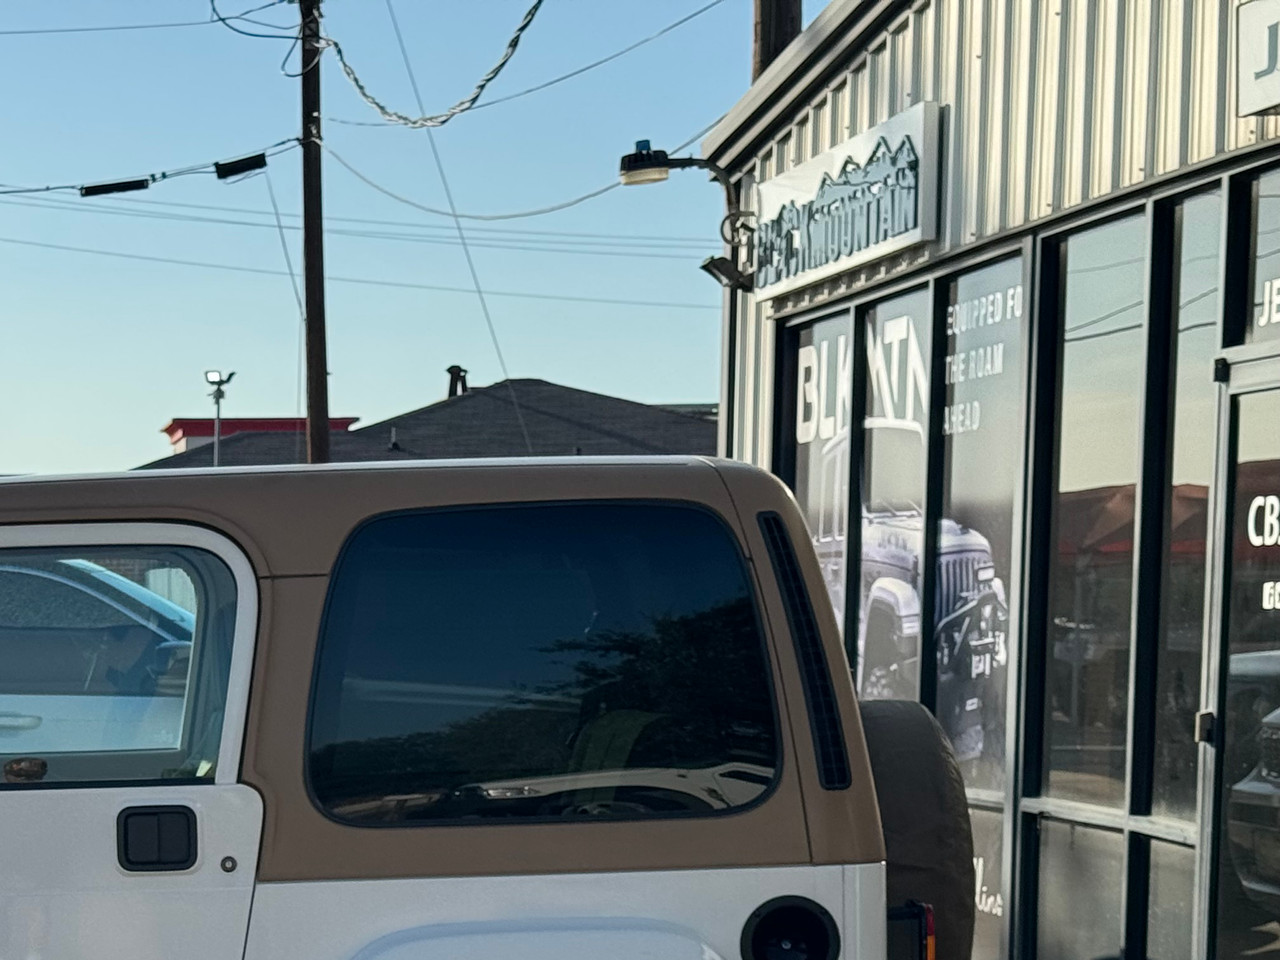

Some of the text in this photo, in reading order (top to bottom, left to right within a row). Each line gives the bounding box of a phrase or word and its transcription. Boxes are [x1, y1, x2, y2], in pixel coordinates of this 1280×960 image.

[945, 343, 1004, 384] THE ROAM
[943, 401, 981, 436] AHEAD
[1248, 495, 1280, 547] CB
